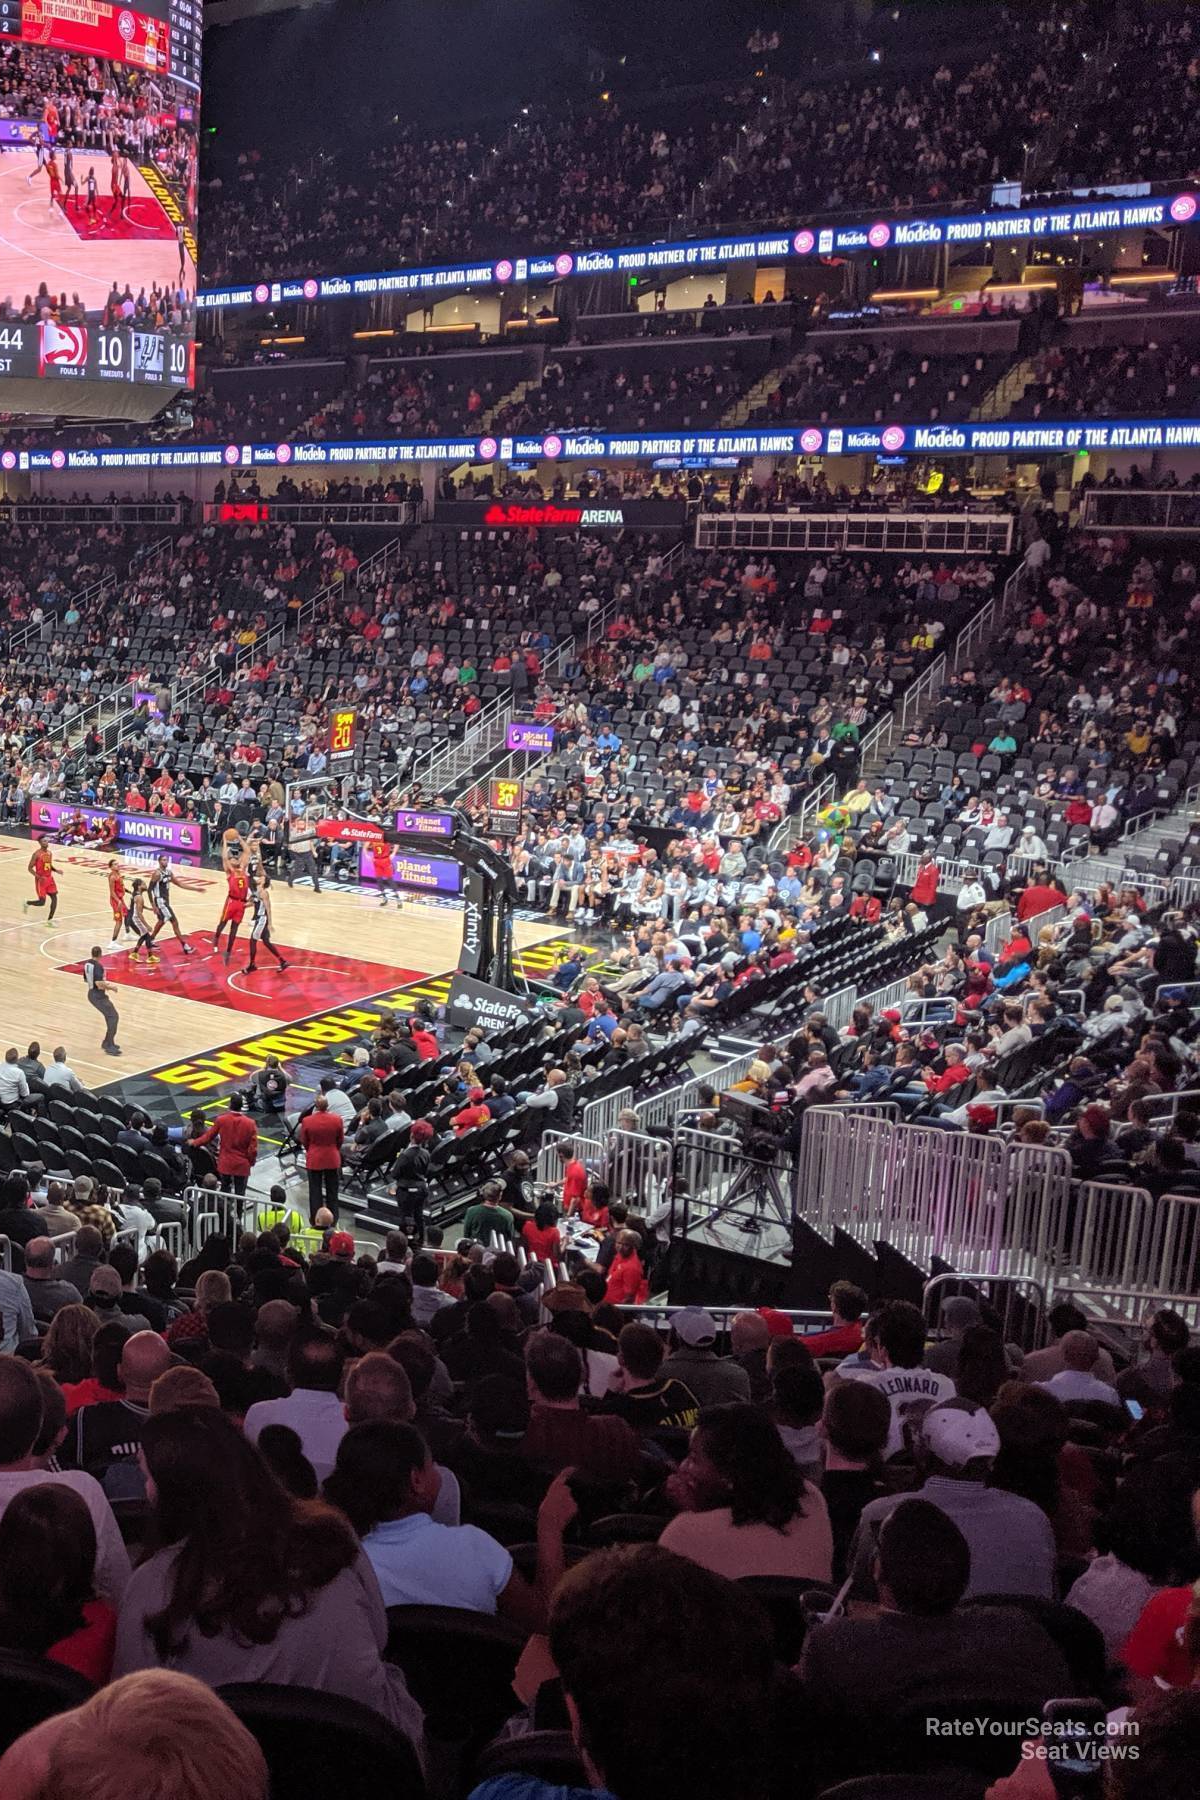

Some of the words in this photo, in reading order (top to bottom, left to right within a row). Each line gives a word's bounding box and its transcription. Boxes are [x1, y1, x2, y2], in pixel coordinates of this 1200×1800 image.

[2, 4, 8, 14] 0
[55, 5, 80, 21] FIGHTING
[81, 10, 96, 24] SPIRIT
[2, 22, 9, 32] 2
[895, 226, 941, 243] Modelo
[946, 222, 982, 238] PROUD
[984, 218, 1031, 236] PARTNER
[1032, 216, 1048, 232] OF
[1050, 214, 1071, 230] THE
[1072, 210, 1120, 228] ATLANTA
[1123, 206, 1163, 224] HAWKS
[837, 234, 867, 245] Modelo
[577, 256, 613, 271] Modelo
[618, 253, 646, 267] PROUD
[647, 249, 685, 264] PARTNER
[686, 248, 698, 261] OF
[699, 246, 716, 260] THE
[718, 243, 755, 258] ATLANTA
[757, 239, 788, 254] HAWKS
[321, 281, 350, 294] Modelo
[354, 279, 377, 292] PROUD
[378, 276, 408, 289] PARTNER
[409, 274, 419, 287] OF
[419, 273, 434, 286] THE
[434, 270, 465, 284] ATLANTA
[466, 268, 492, 281] HAWKS
[205, 293, 230, 305] ATLANTA
[231, 291, 252, 303] HAWKS
[98, 336, 122, 366] 10
[170, 344, 185, 372] 10
[60, 367, 78, 376] FOULS
[100, 369, 124, 378] TIMEOUTS
[848, 435, 880, 447] Modelo
[915, 428, 965, 447] Modelo
[971, 431, 1010, 446] PROUD
[1012, 430, 1064, 446] PARTNER
[1066, 429, 1082, 445] OF
[1084, 429, 1108, 445] THE
[1109, 428, 1162, 444] ATLANTA
[1165, 426, 1200, 443] HAWK
[294, 447, 326, 460] Modelo
[329, 448, 354, 460] PROUD
[354, 447, 386, 459] PARTNER
[387, 446, 398, 459] OF
[399, 446, 414, 459] THE
[414, 445, 447, 458] ATLANTA
[448, 444, 475, 457] HAWKS
[565, 441, 604, 455] Modelo
[609, 440, 639, 454] PROUD
[641, 439, 681, 453] PARTNER
[683, 439, 696, 452] OF
[697, 438, 715, 452] THE
[716, 437, 757, 452] ATLANTA
[759, 436, 794, 450] HAWKS
[68, 454, 97, 466] Modelo
[101, 454, 123, 465] PROUD
[124, 453, 150, 465] PARTNER
[151, 452, 159, 464] OF
[160, 452, 172, 464] THE
[172, 452, 199, 464] ATLANTA
[199, 451, 222, 463] HAWKS
[581, 510, 623, 523] ARENA
[334, 726, 350, 748] 20
[497, 792, 513, 806] 20
[415, 817, 441, 827] planet
[418, 825, 445, 833] fitness
[124, 821, 173, 841] MONTH
[377, 846, 382, 855] 3
[396, 861, 431, 877] planet
[238, 880, 243, 888] 5
[401, 872, 438, 885] fitness
[464, 902, 482, 954] xfinity
[473, 997, 521, 1020] StateFa
[476, 1016, 504, 1029] AREN
[152, 1008, 382, 1091] HAWKS
[880, 1376, 940, 1397] LEONARD
